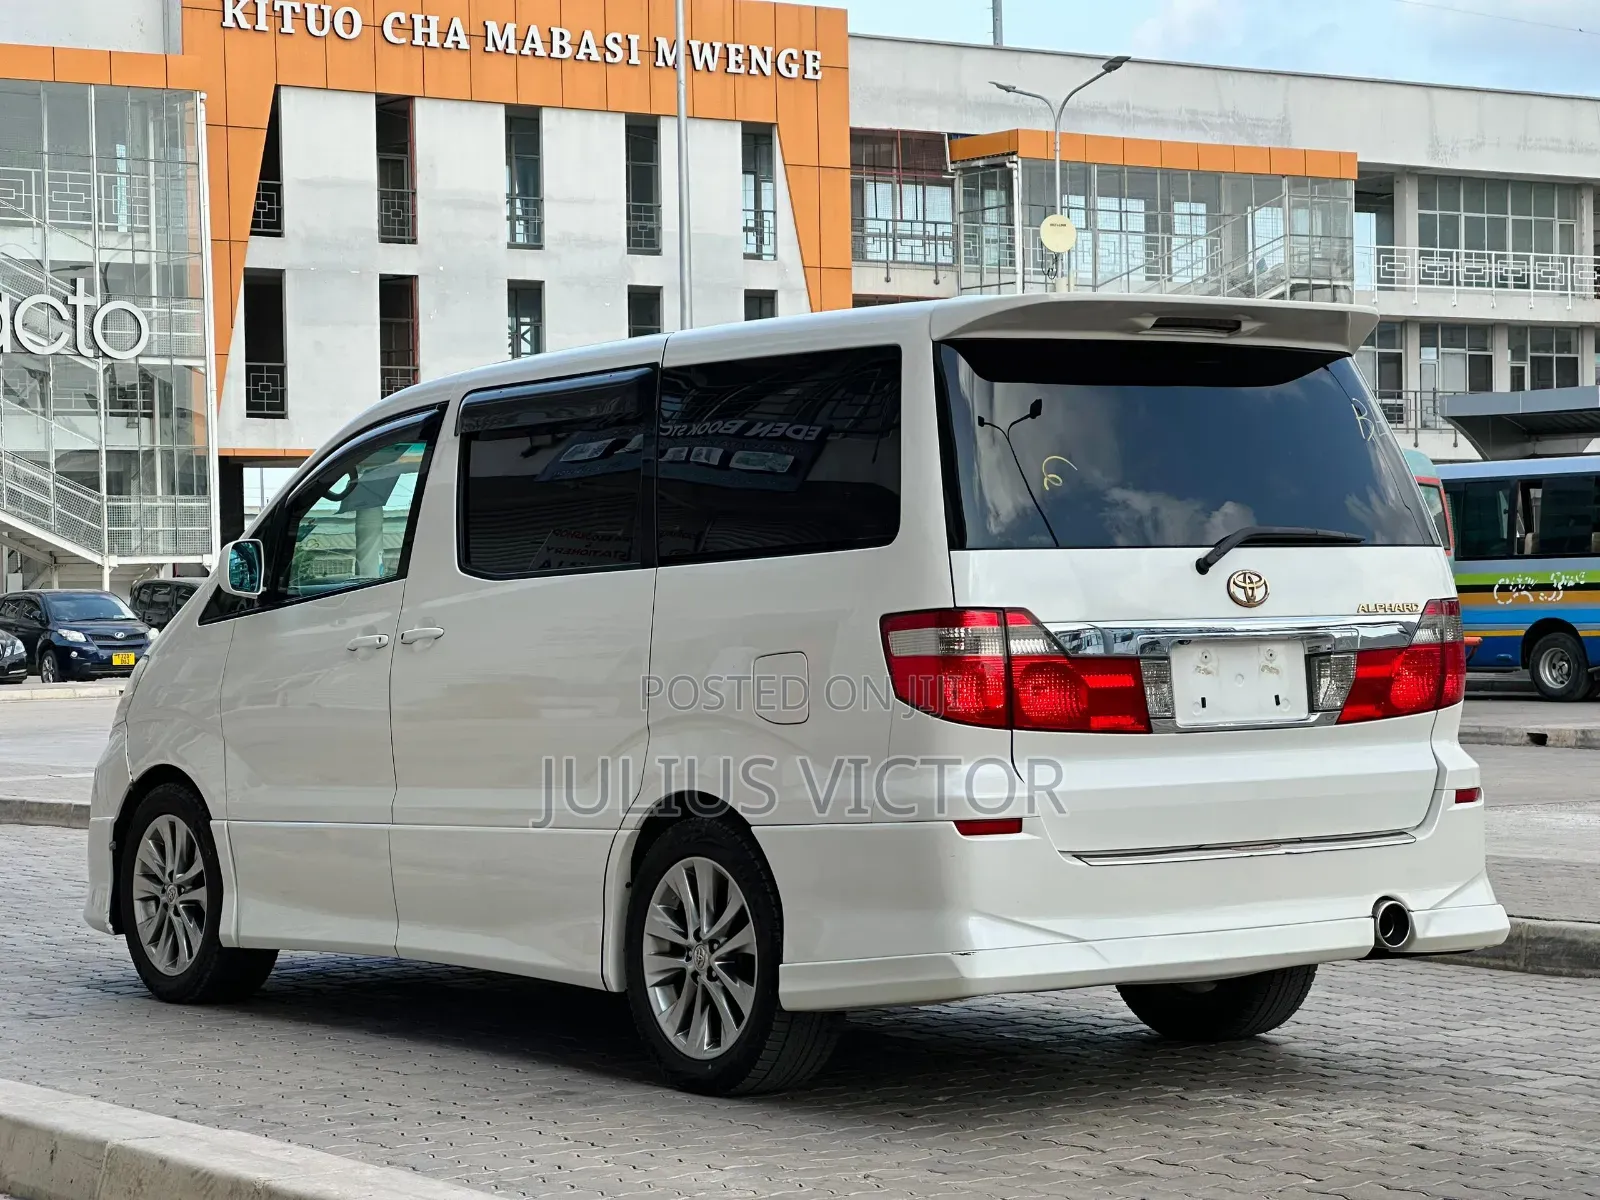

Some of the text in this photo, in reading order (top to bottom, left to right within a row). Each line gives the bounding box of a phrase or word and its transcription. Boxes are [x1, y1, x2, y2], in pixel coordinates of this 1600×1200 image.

[222, 0, 822, 80] KITUO CHA MABASI MWENGE
[1356, 603, 1420, 613] ALPHARD
